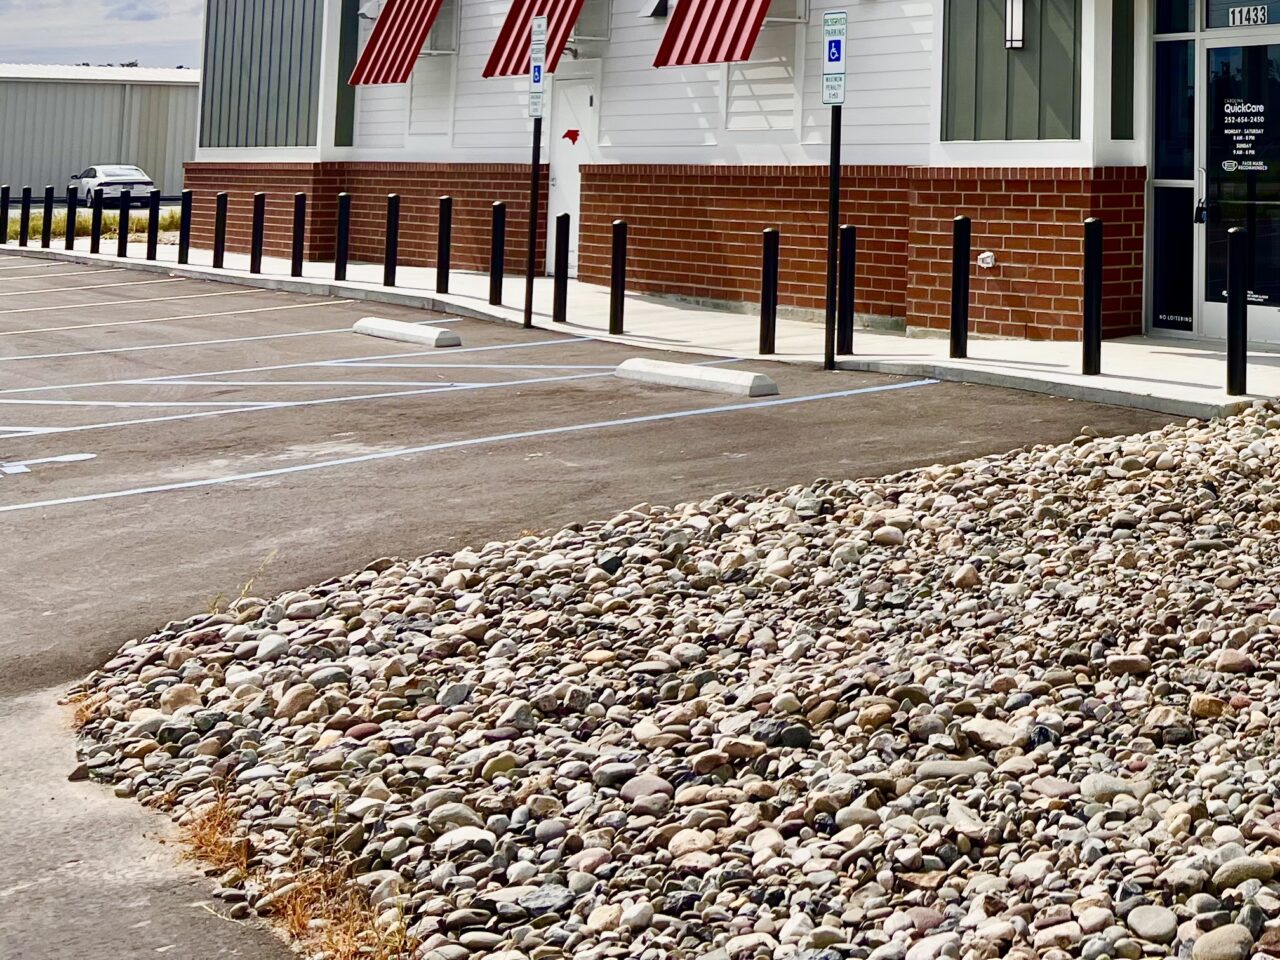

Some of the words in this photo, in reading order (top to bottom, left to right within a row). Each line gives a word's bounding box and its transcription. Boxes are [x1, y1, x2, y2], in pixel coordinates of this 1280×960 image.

[1231, 6, 1266, 25] 11433
[825, 28, 845, 37] PARKING
[1224, 103, 1265, 113] QuickCare
